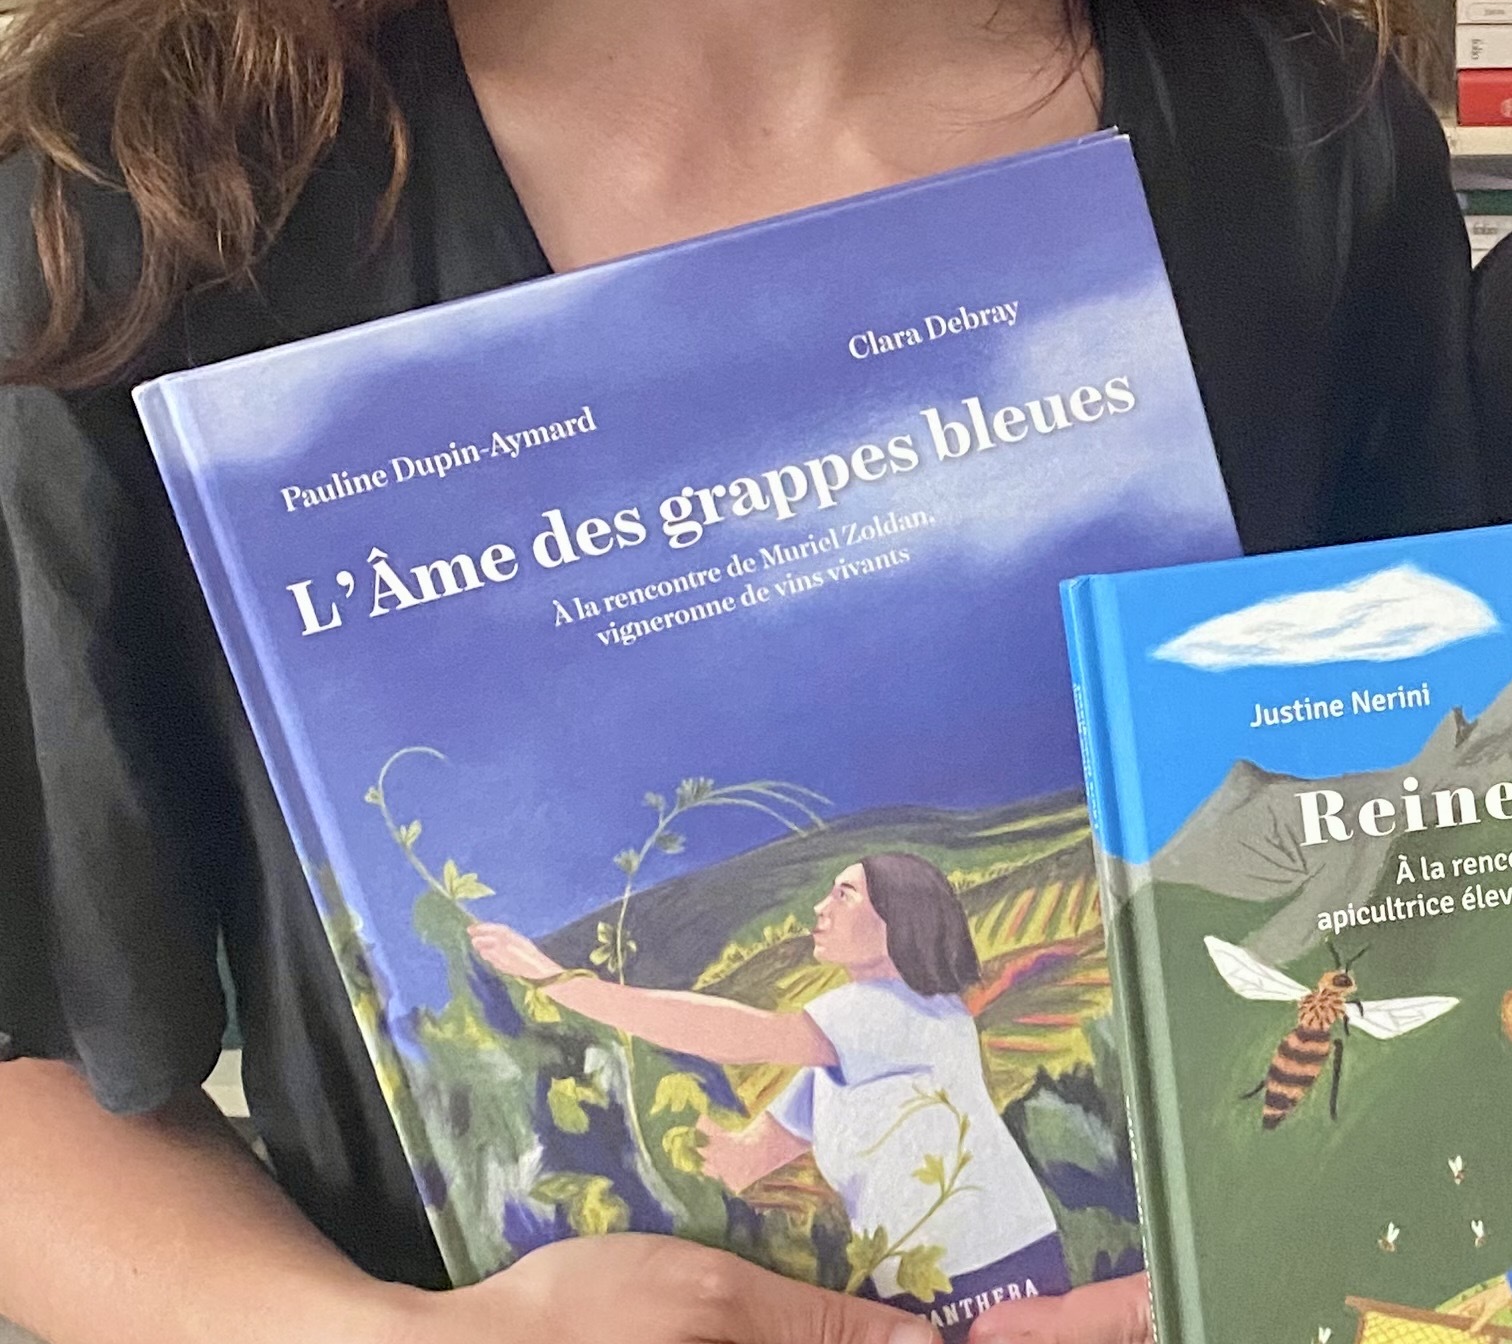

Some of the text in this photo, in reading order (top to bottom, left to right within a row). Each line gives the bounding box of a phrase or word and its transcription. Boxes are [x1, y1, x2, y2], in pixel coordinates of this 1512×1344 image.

[848, 299, 1021, 359] Clara Debray
[281, 406, 598, 512] Pauline Dupin-Aymard
[287, 375, 1137, 636] L’Âme des grappes bleues
[553, 599, 573, 627] À
[575, 596, 602, 622] la
[602, 564, 722, 614] rencontre
[725, 551, 757, 578] de
[761, 526, 841, 568] Muriel
[596, 546, 912, 647] vigneronne de vins vivants
[1250, 682, 1432, 729] Justine Nerini
[1395, 853, 1416, 885] À
[1420, 856, 1446, 883] la
[1316, 891, 1456, 935] apicultrice
[921, 1277, 1040, 1330] ANTHERA
